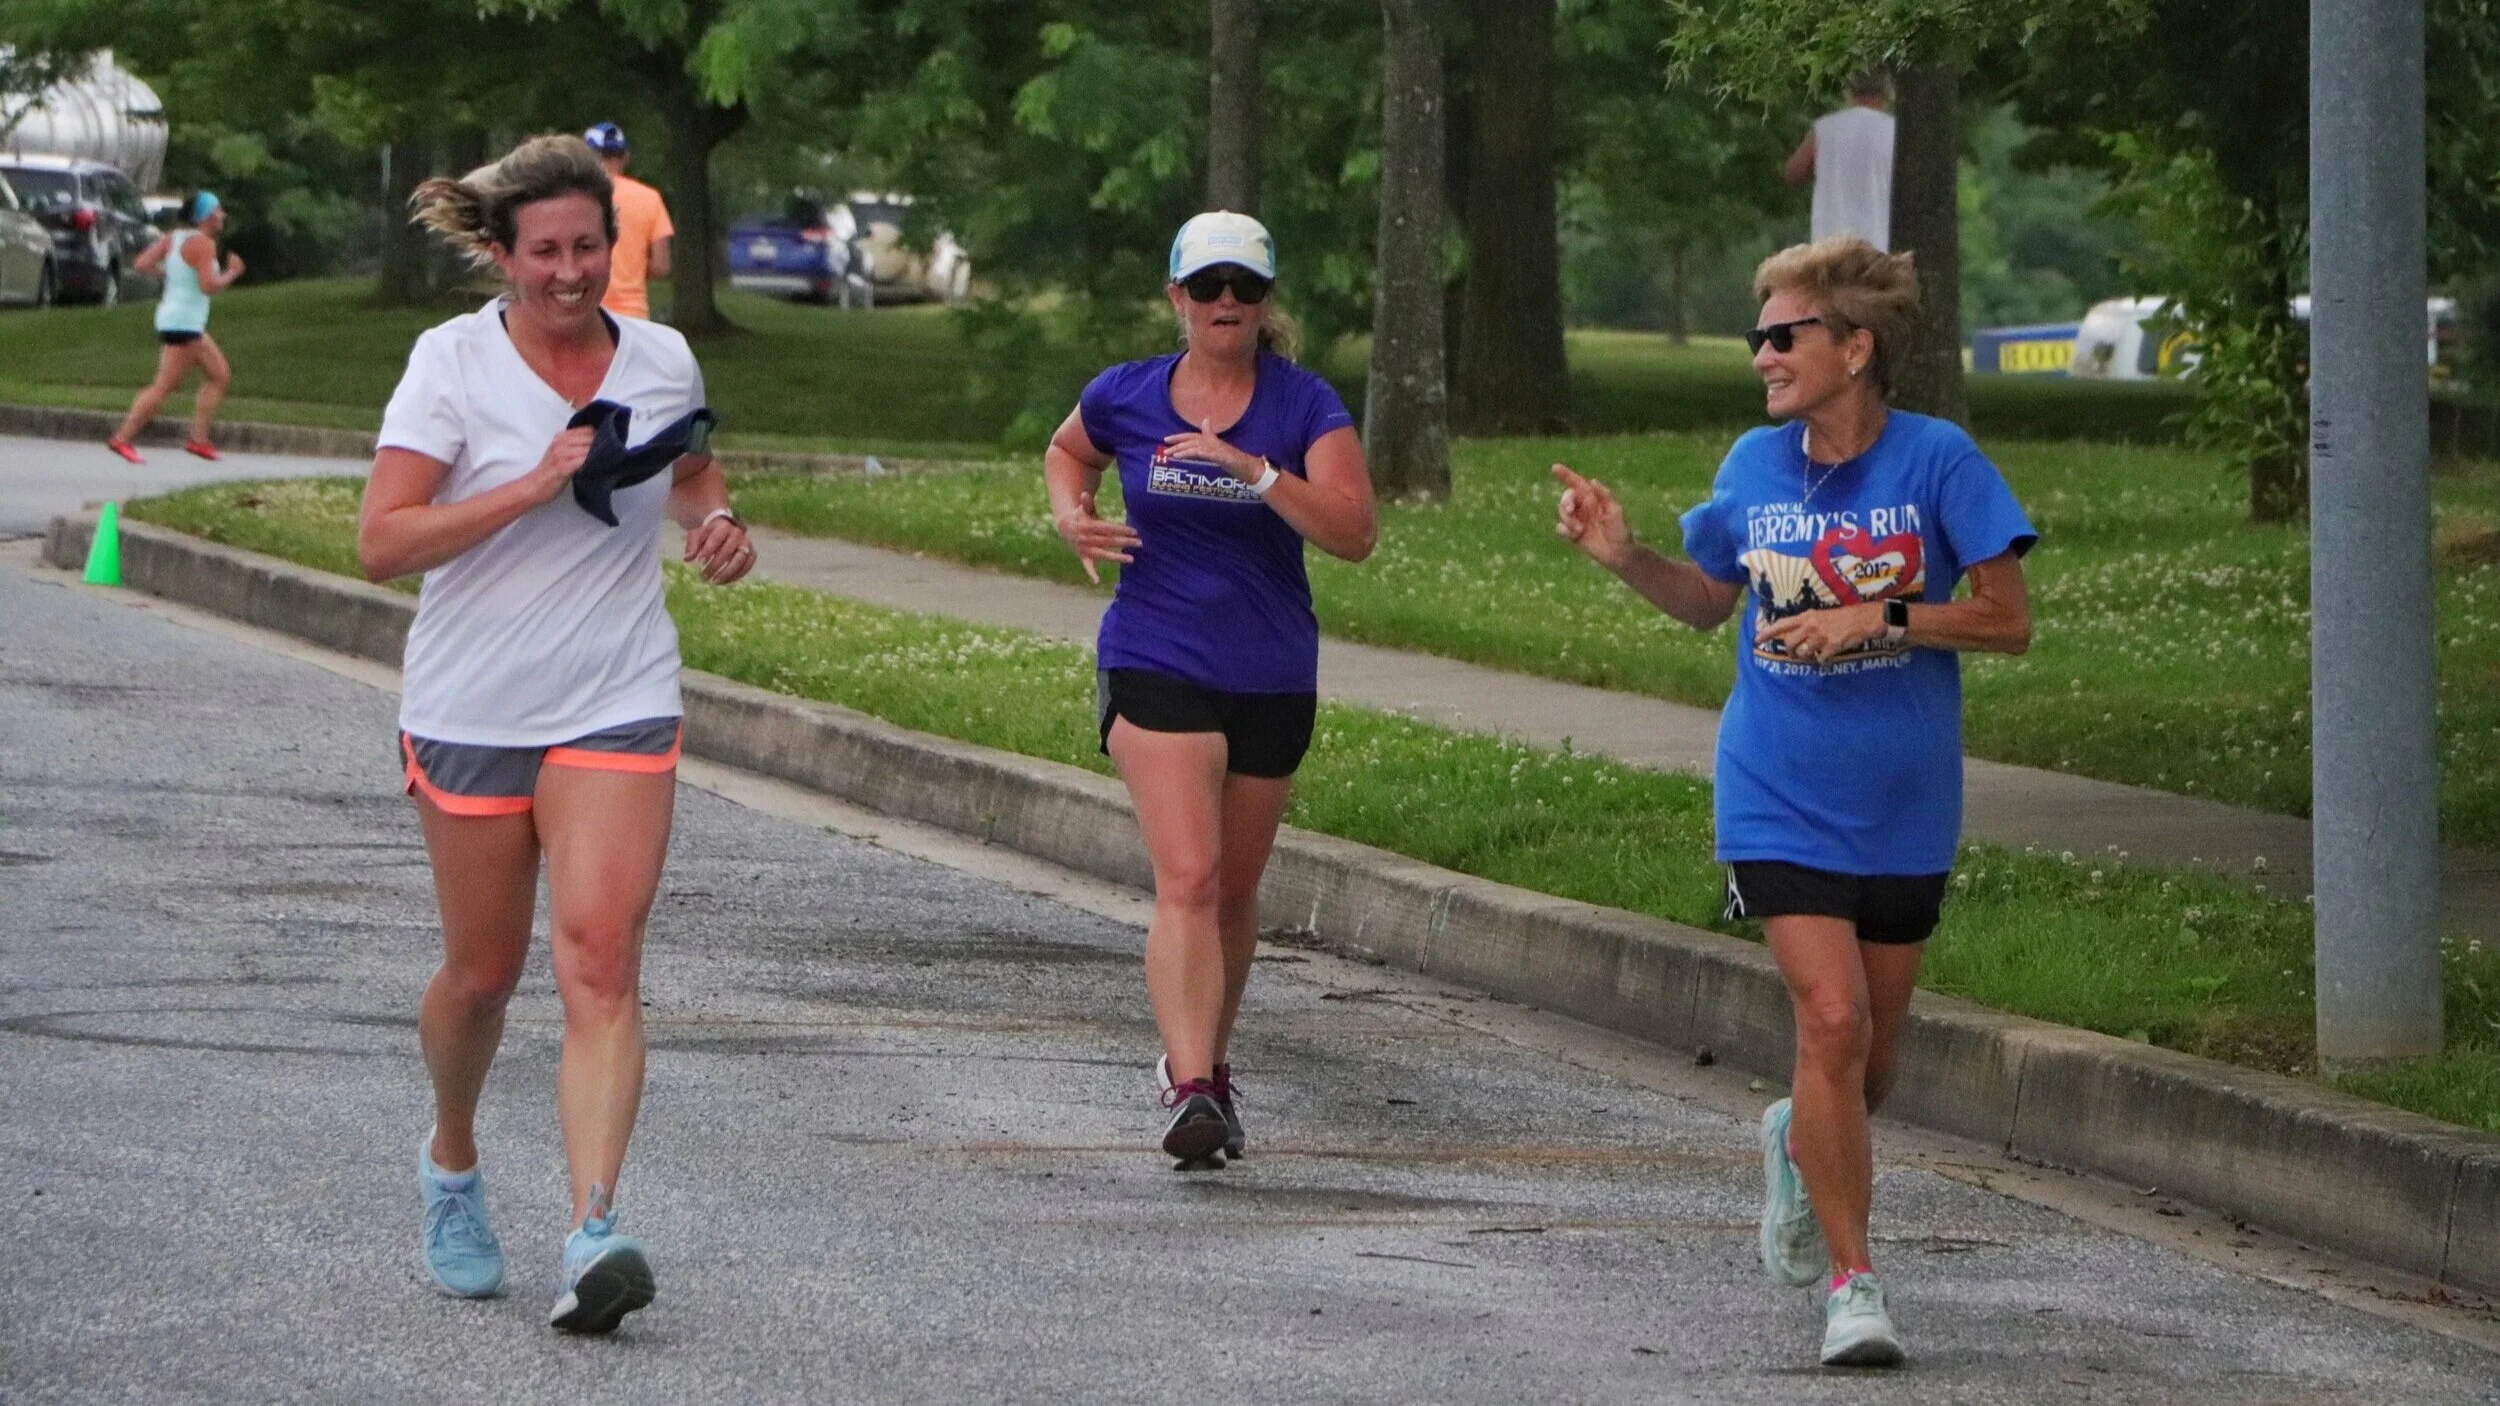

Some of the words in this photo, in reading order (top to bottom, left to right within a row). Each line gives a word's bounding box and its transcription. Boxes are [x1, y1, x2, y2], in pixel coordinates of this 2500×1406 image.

[1153, 470, 1247, 490] BALTIMOR
[1761, 501, 1807, 516] ANNUAL
[1746, 511, 1858, 549] JEREMY'S
[1870, 503, 1922, 538] RUN
[1853, 560, 1891, 579] 2017
[1783, 662, 1812, 676] 2017
